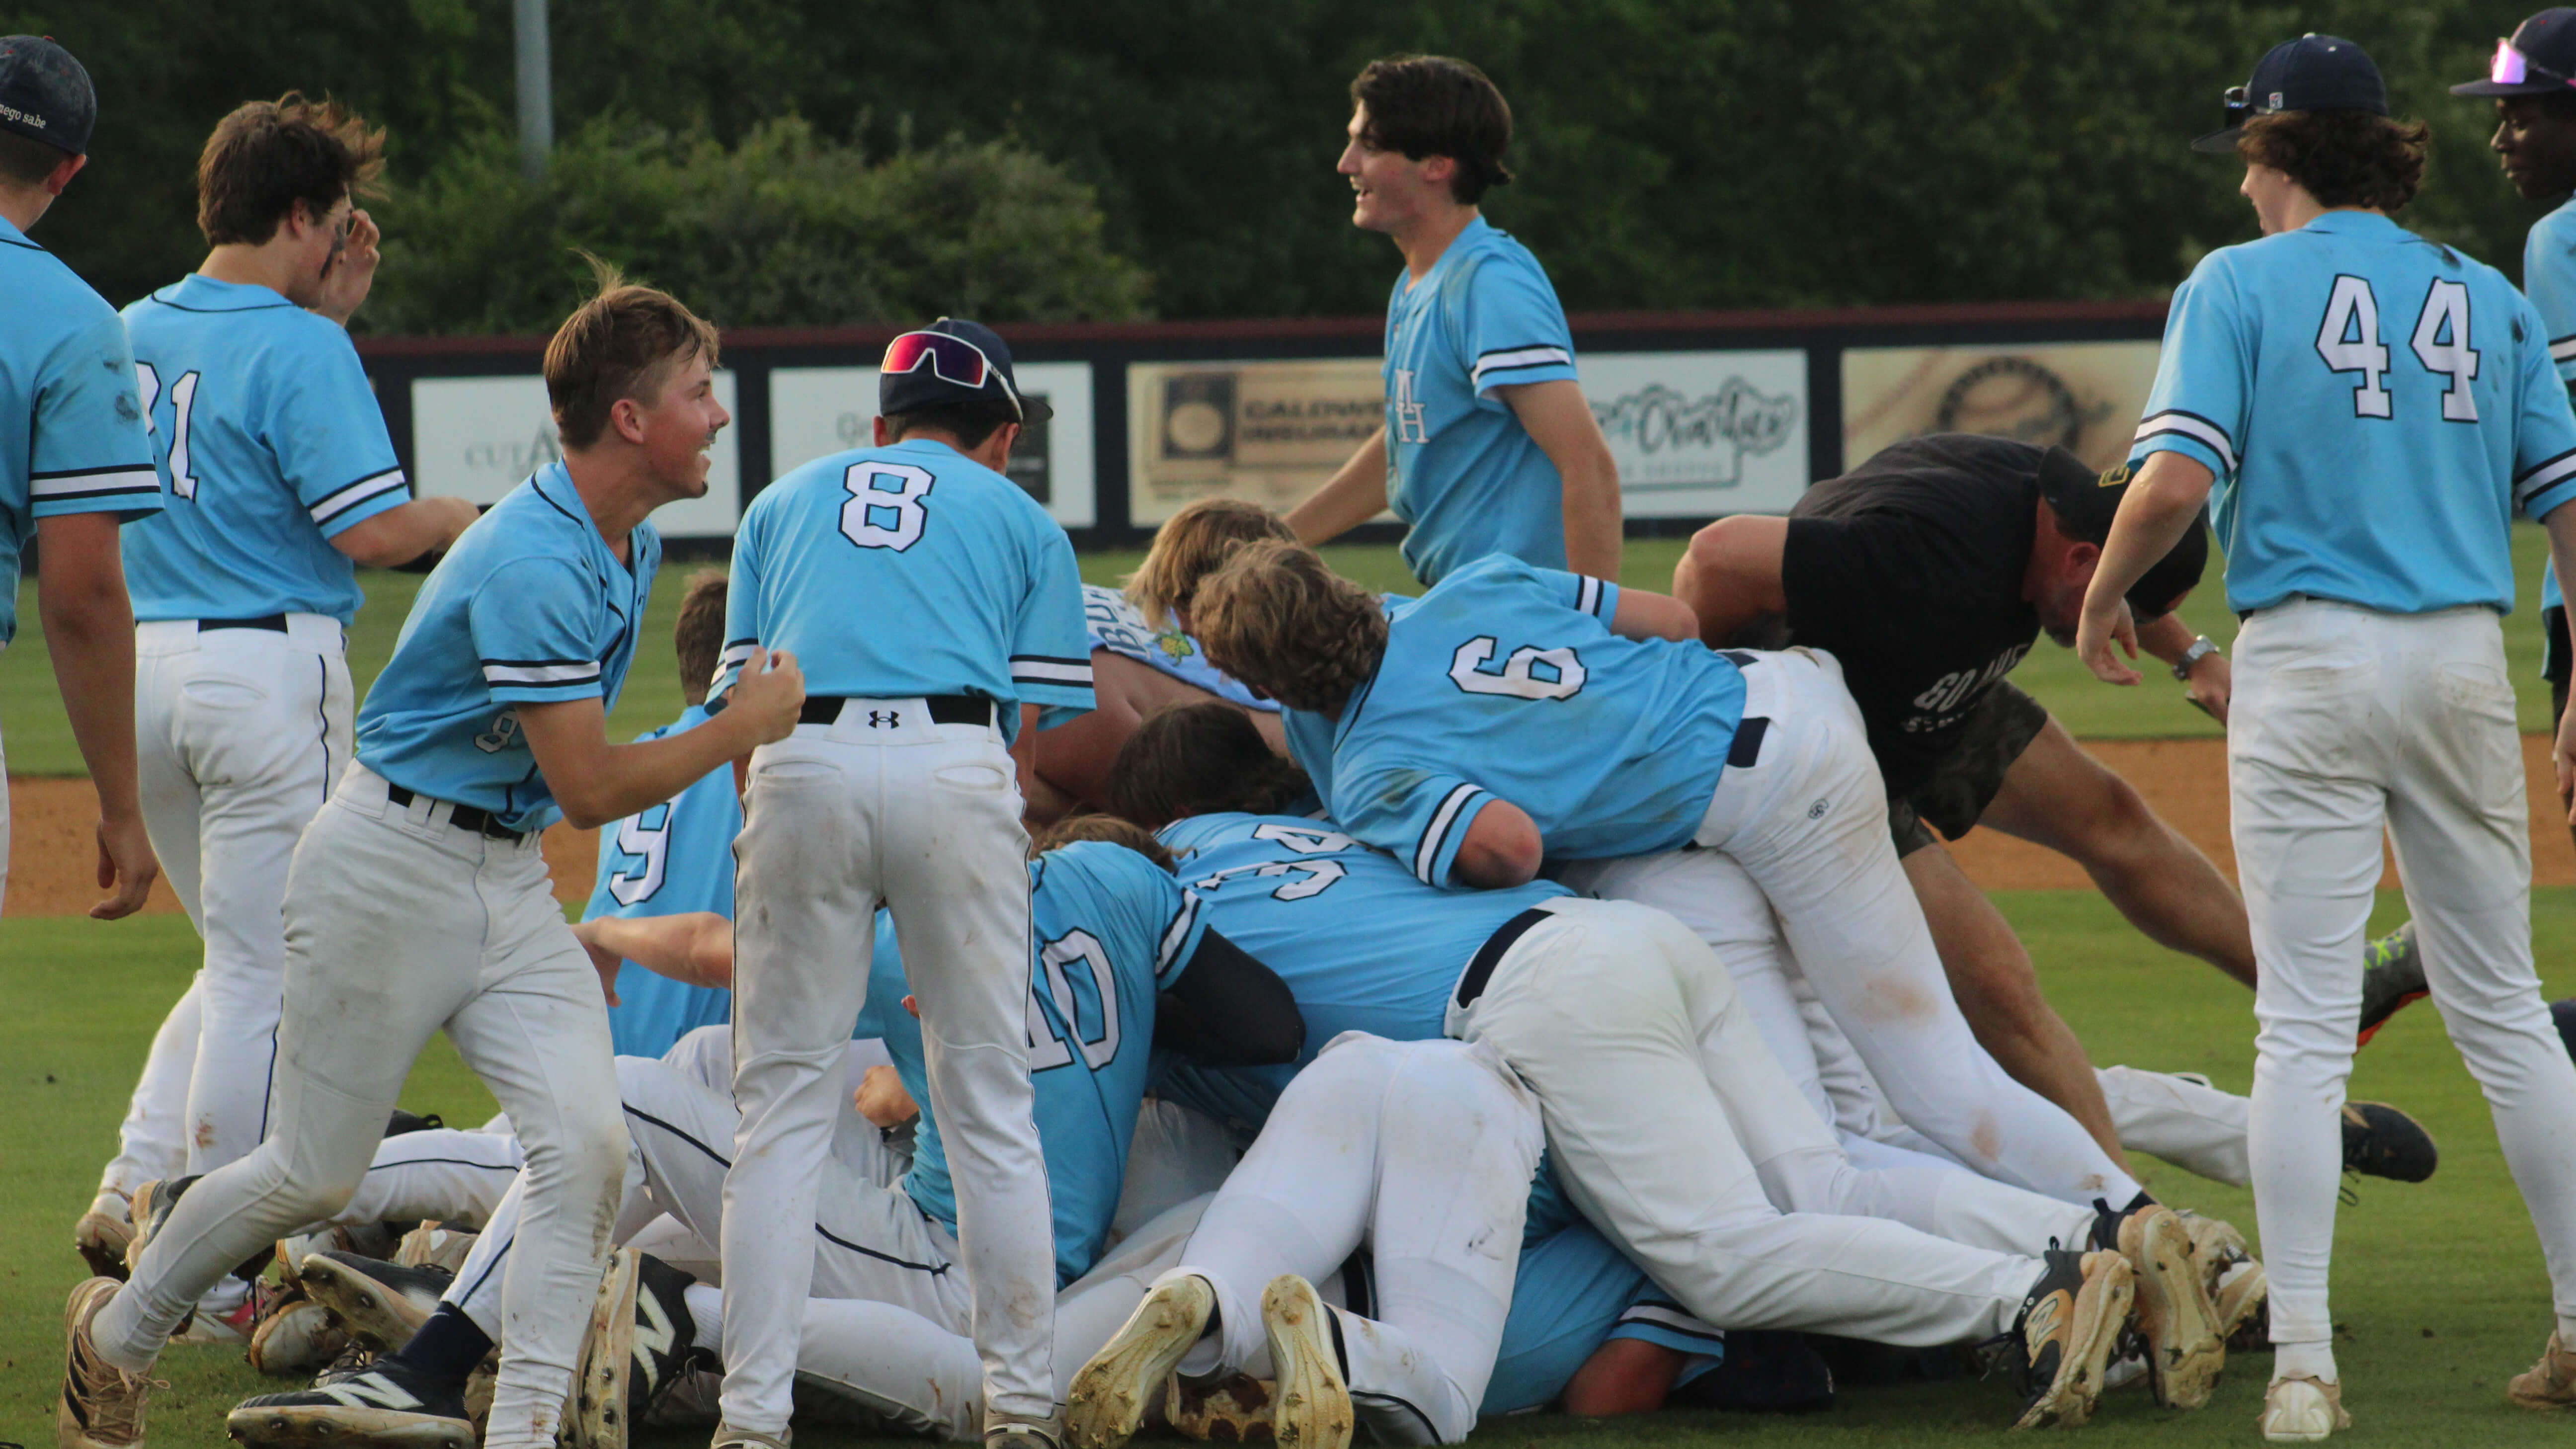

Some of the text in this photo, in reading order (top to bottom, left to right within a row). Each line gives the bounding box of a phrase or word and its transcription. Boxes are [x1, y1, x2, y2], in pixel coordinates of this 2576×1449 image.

[22, 113, 46, 129] sabe
[2314, 273, 2481, 424] 44
[838, 460, 936, 553] 8
[609, 793, 686, 907] 9
